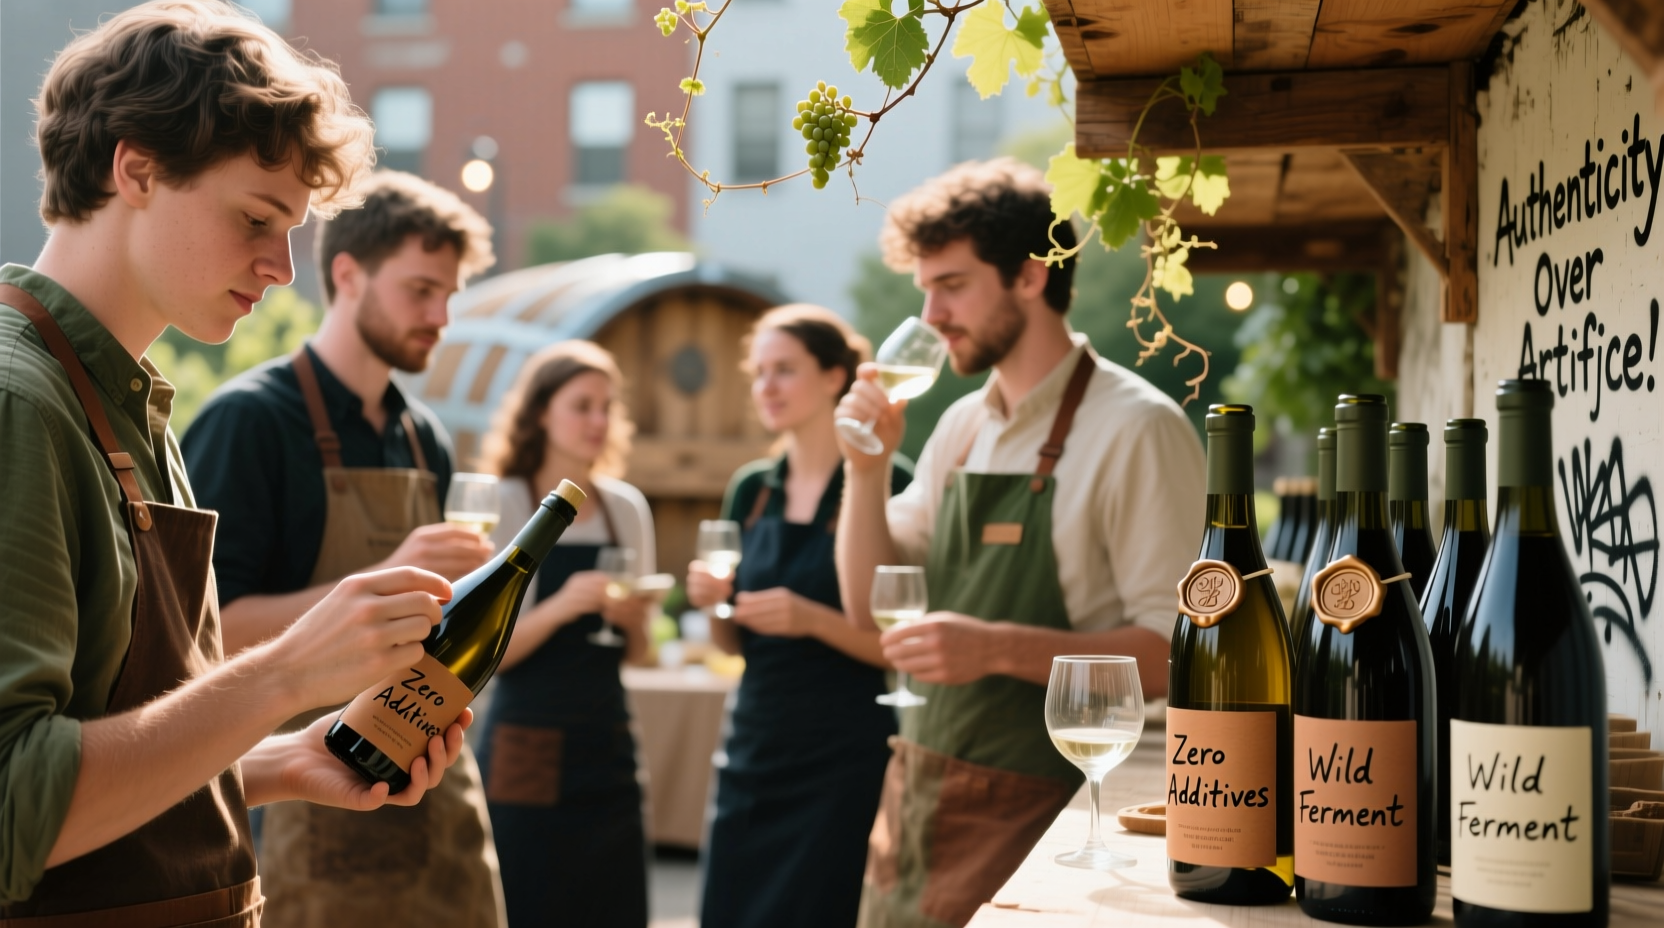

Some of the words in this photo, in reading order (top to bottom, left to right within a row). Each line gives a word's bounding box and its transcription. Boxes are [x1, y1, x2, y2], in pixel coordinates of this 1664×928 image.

[1494, 112, 1664, 267] Authenticity
[1534, 247, 1604, 317] Over
[400, 667, 445, 706] Zero
[1172, 733, 1225, 765] Zero
[1309, 742, 1374, 784] Wild
[1167, 772, 1270, 808] Additives
[1468, 752, 1546, 794] Wild
[1299, 789, 1405, 827] Ferment
[1458, 801, 1580, 842] Ferment
